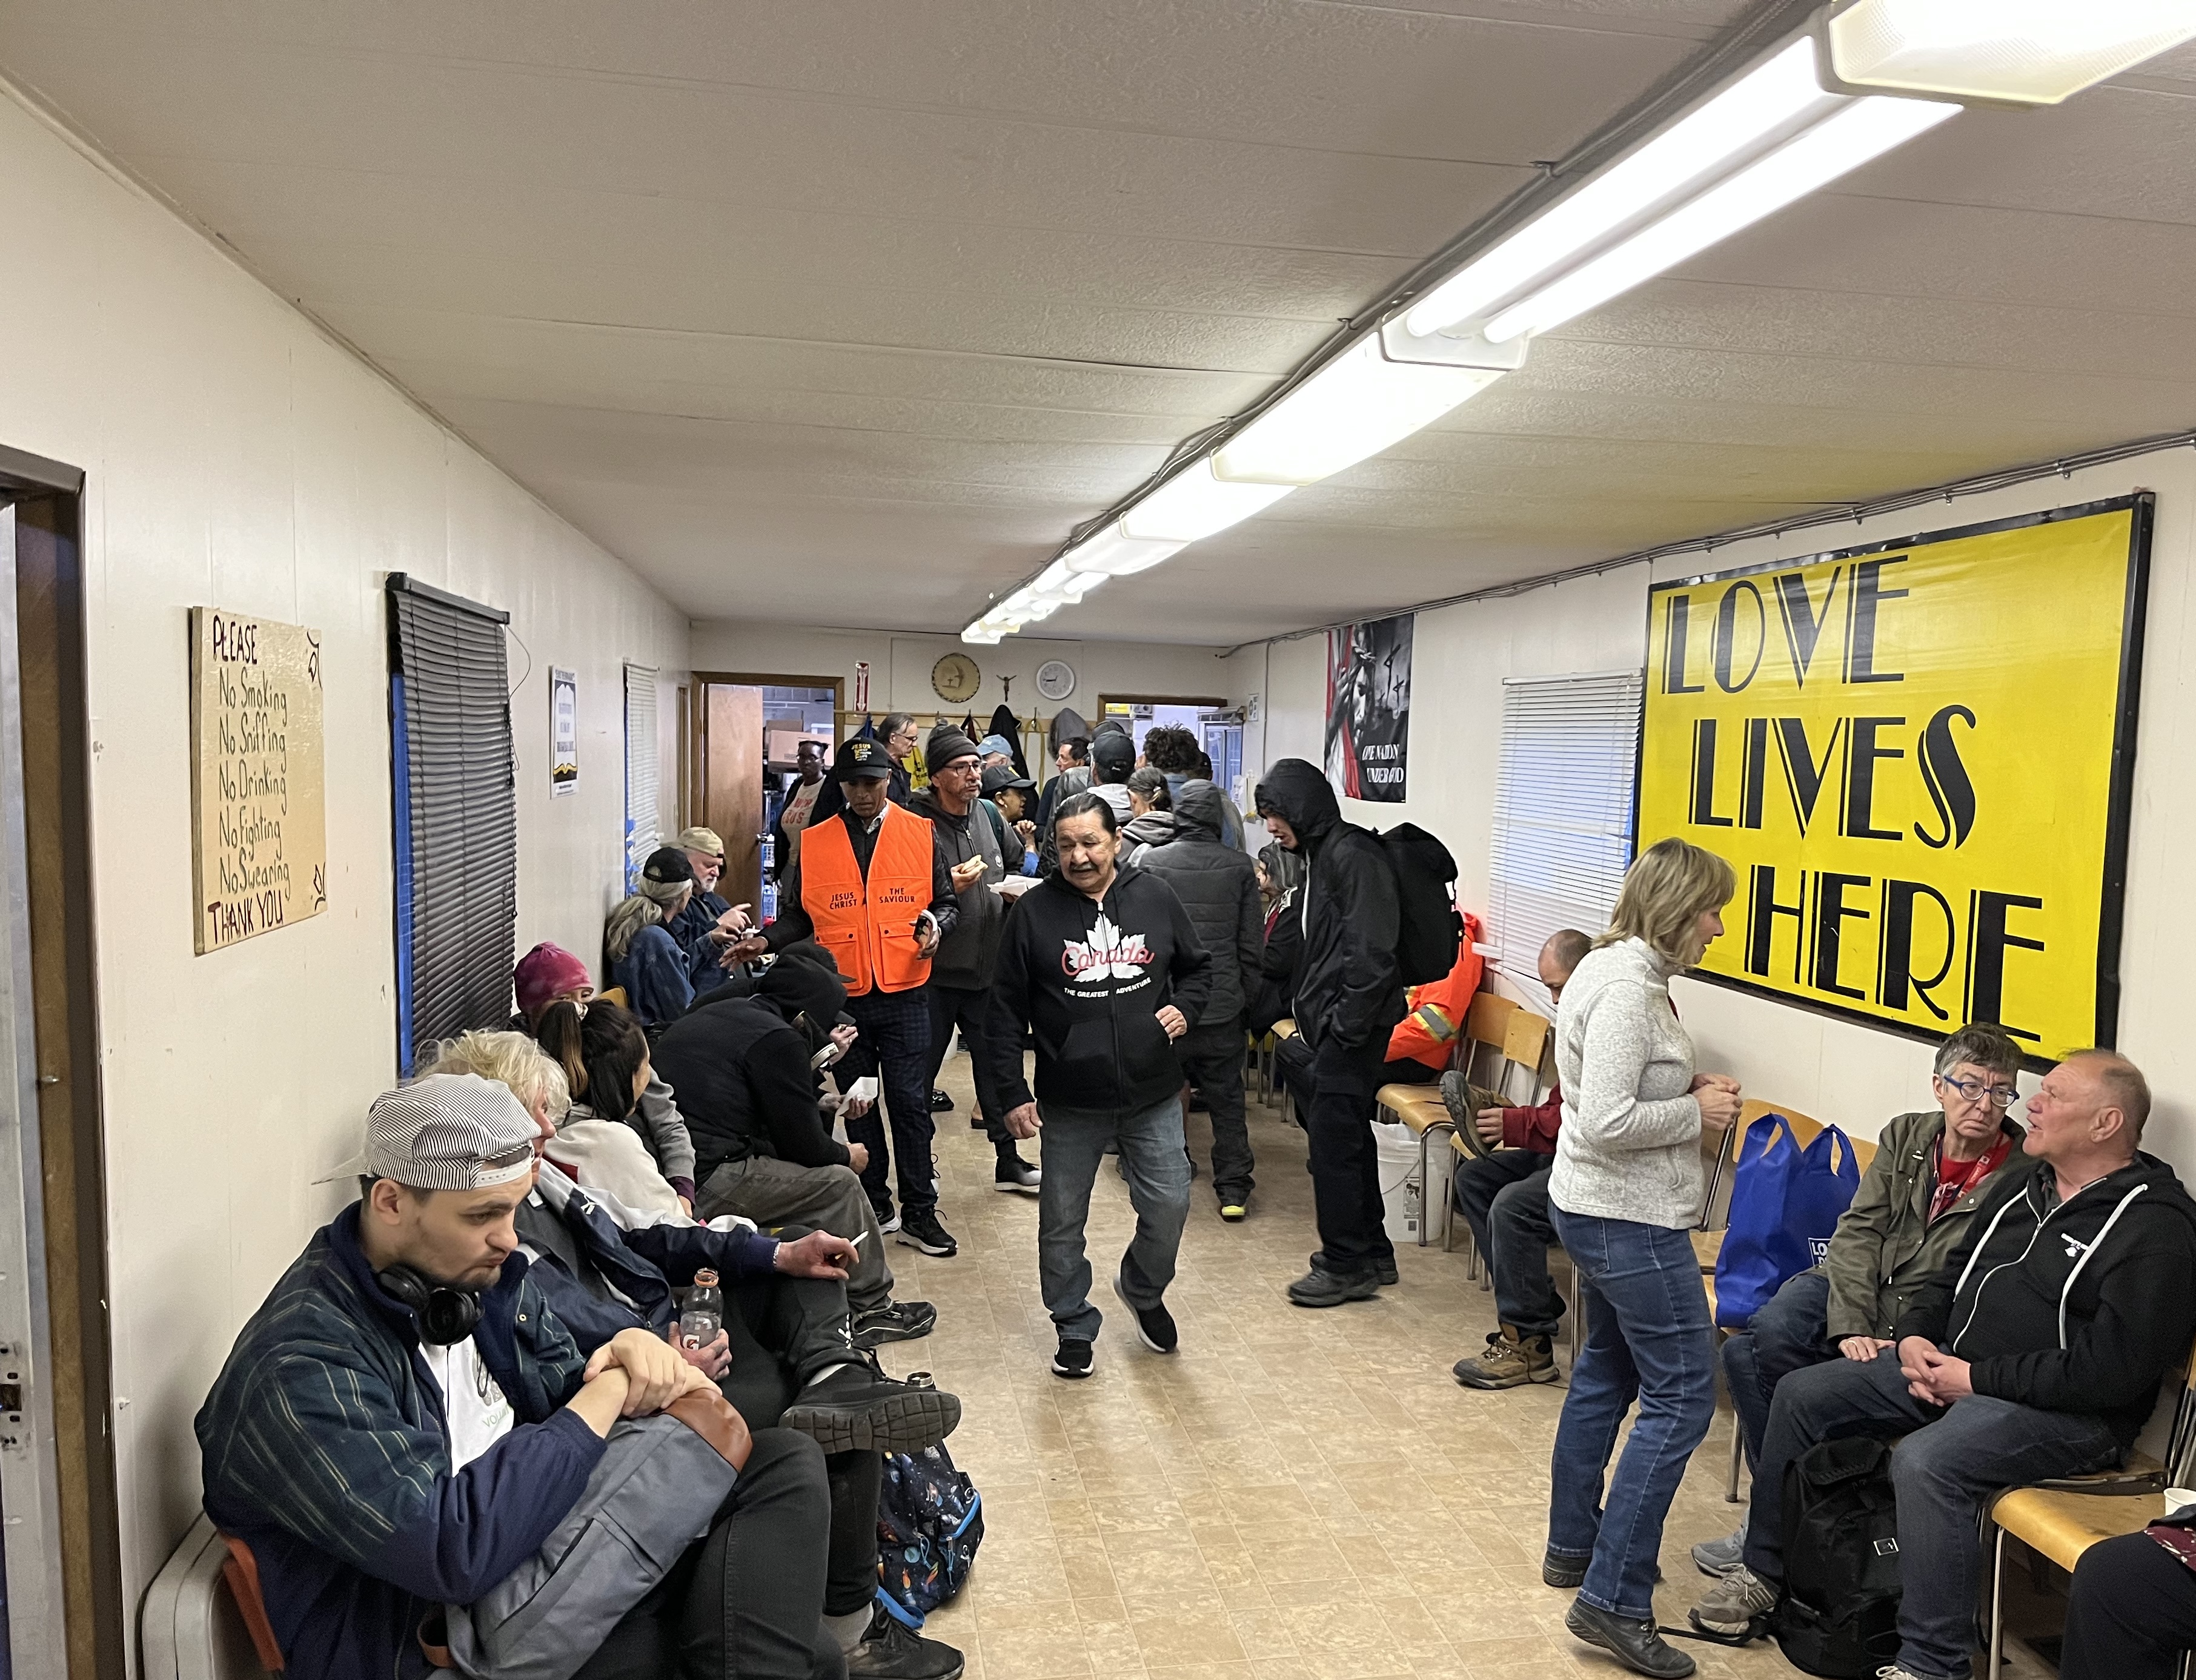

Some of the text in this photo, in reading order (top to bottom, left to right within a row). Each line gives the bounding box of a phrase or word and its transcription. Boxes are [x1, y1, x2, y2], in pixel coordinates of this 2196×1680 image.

[213, 615, 257, 664] PLEASE
[1661, 555, 1909, 694] LOVE
[219, 666, 288, 727] No Smoking
[219, 711, 288, 774] No Sniffing
[219, 758, 287, 816] No Drinking
[1688, 705, 1977, 849] LIVES
[219, 805, 282, 862] No Fighting
[219, 847, 291, 901] No Swearing
[831, 891, 854, 902] JESUS
[207, 889, 284, 945] THANK YOU
[829, 899, 857, 910] CHRIST
[1061, 942, 1156, 976] Canada
[1744, 864, 2045, 1042] HERE
[1064, 976, 1152, 998] THE GREATEST ADVENTURE
